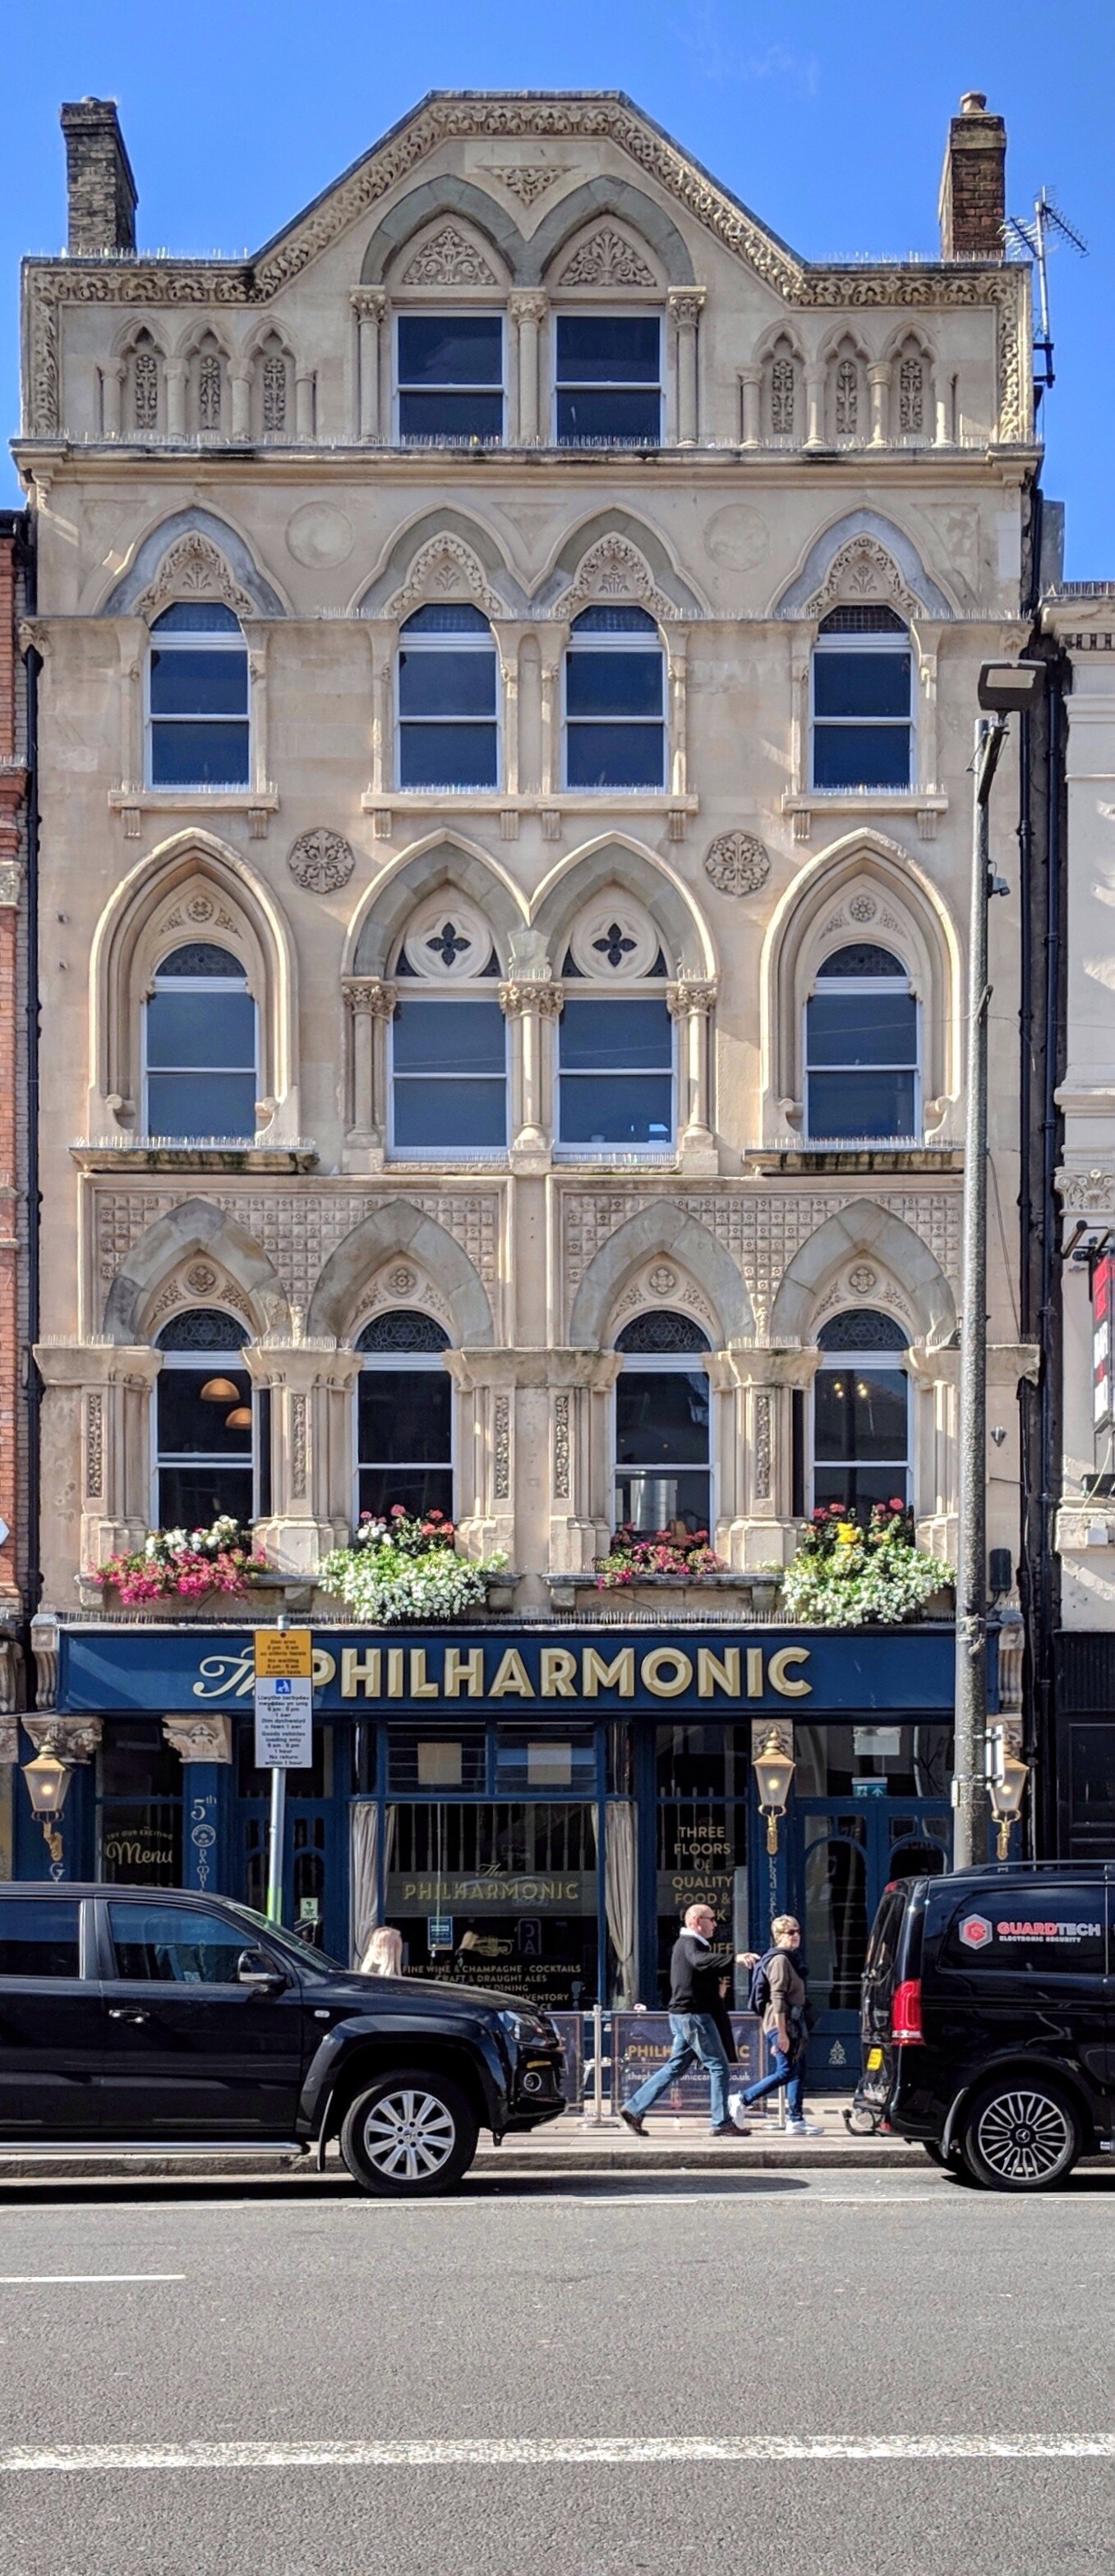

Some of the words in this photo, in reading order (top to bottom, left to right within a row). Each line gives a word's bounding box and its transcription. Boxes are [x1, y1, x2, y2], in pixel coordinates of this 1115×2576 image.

[679, 1827, 726, 1838] THREE
[106, 1842, 173, 1865] Menu
[674, 1843, 731, 1855] FLOORS
[672, 1876, 733, 1888] QUALITY
[403, 1882, 579, 1900] PHILHARMONIC
[675, 1893, 717, 1904] FOOD
[721, 1893, 730, 1904] &
[997, 1921, 1101, 1937] GUARDTECH
[529, 1965, 582, 1973] COCKTAILS
